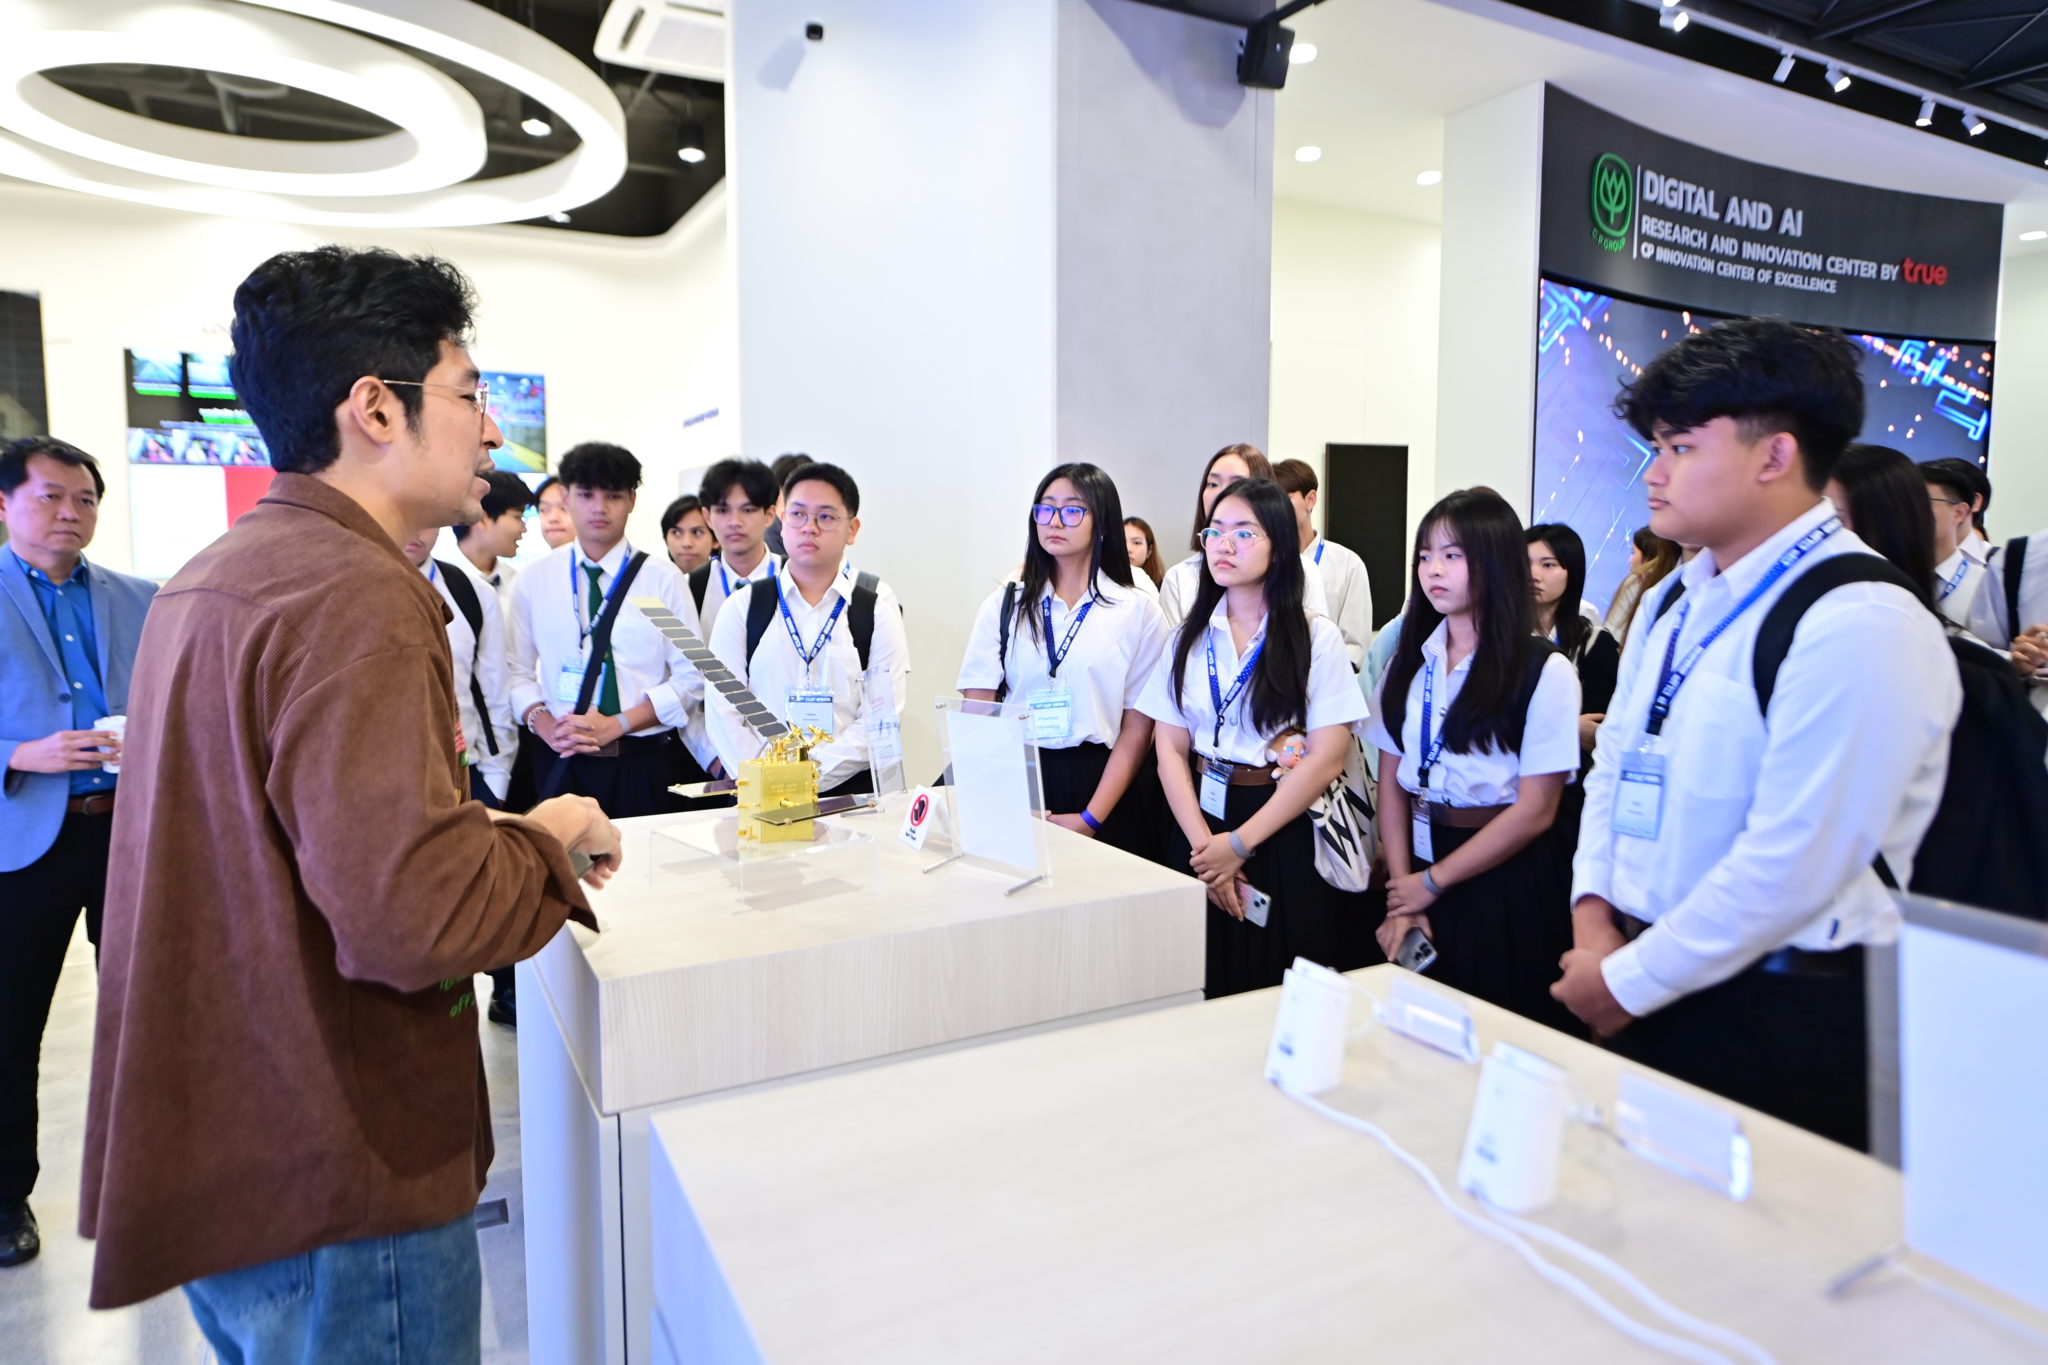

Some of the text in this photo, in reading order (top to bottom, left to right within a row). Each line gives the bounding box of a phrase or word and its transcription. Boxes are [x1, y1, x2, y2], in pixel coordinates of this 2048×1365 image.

[1643, 169, 1803, 237] DIGITAL AND AI
[1640, 241, 1837, 294] CP INNOVATION CENTER OF EXCELLENCE
[1641, 214, 1948, 286] RESEARCH AND INNOVATION CENTER BY true
